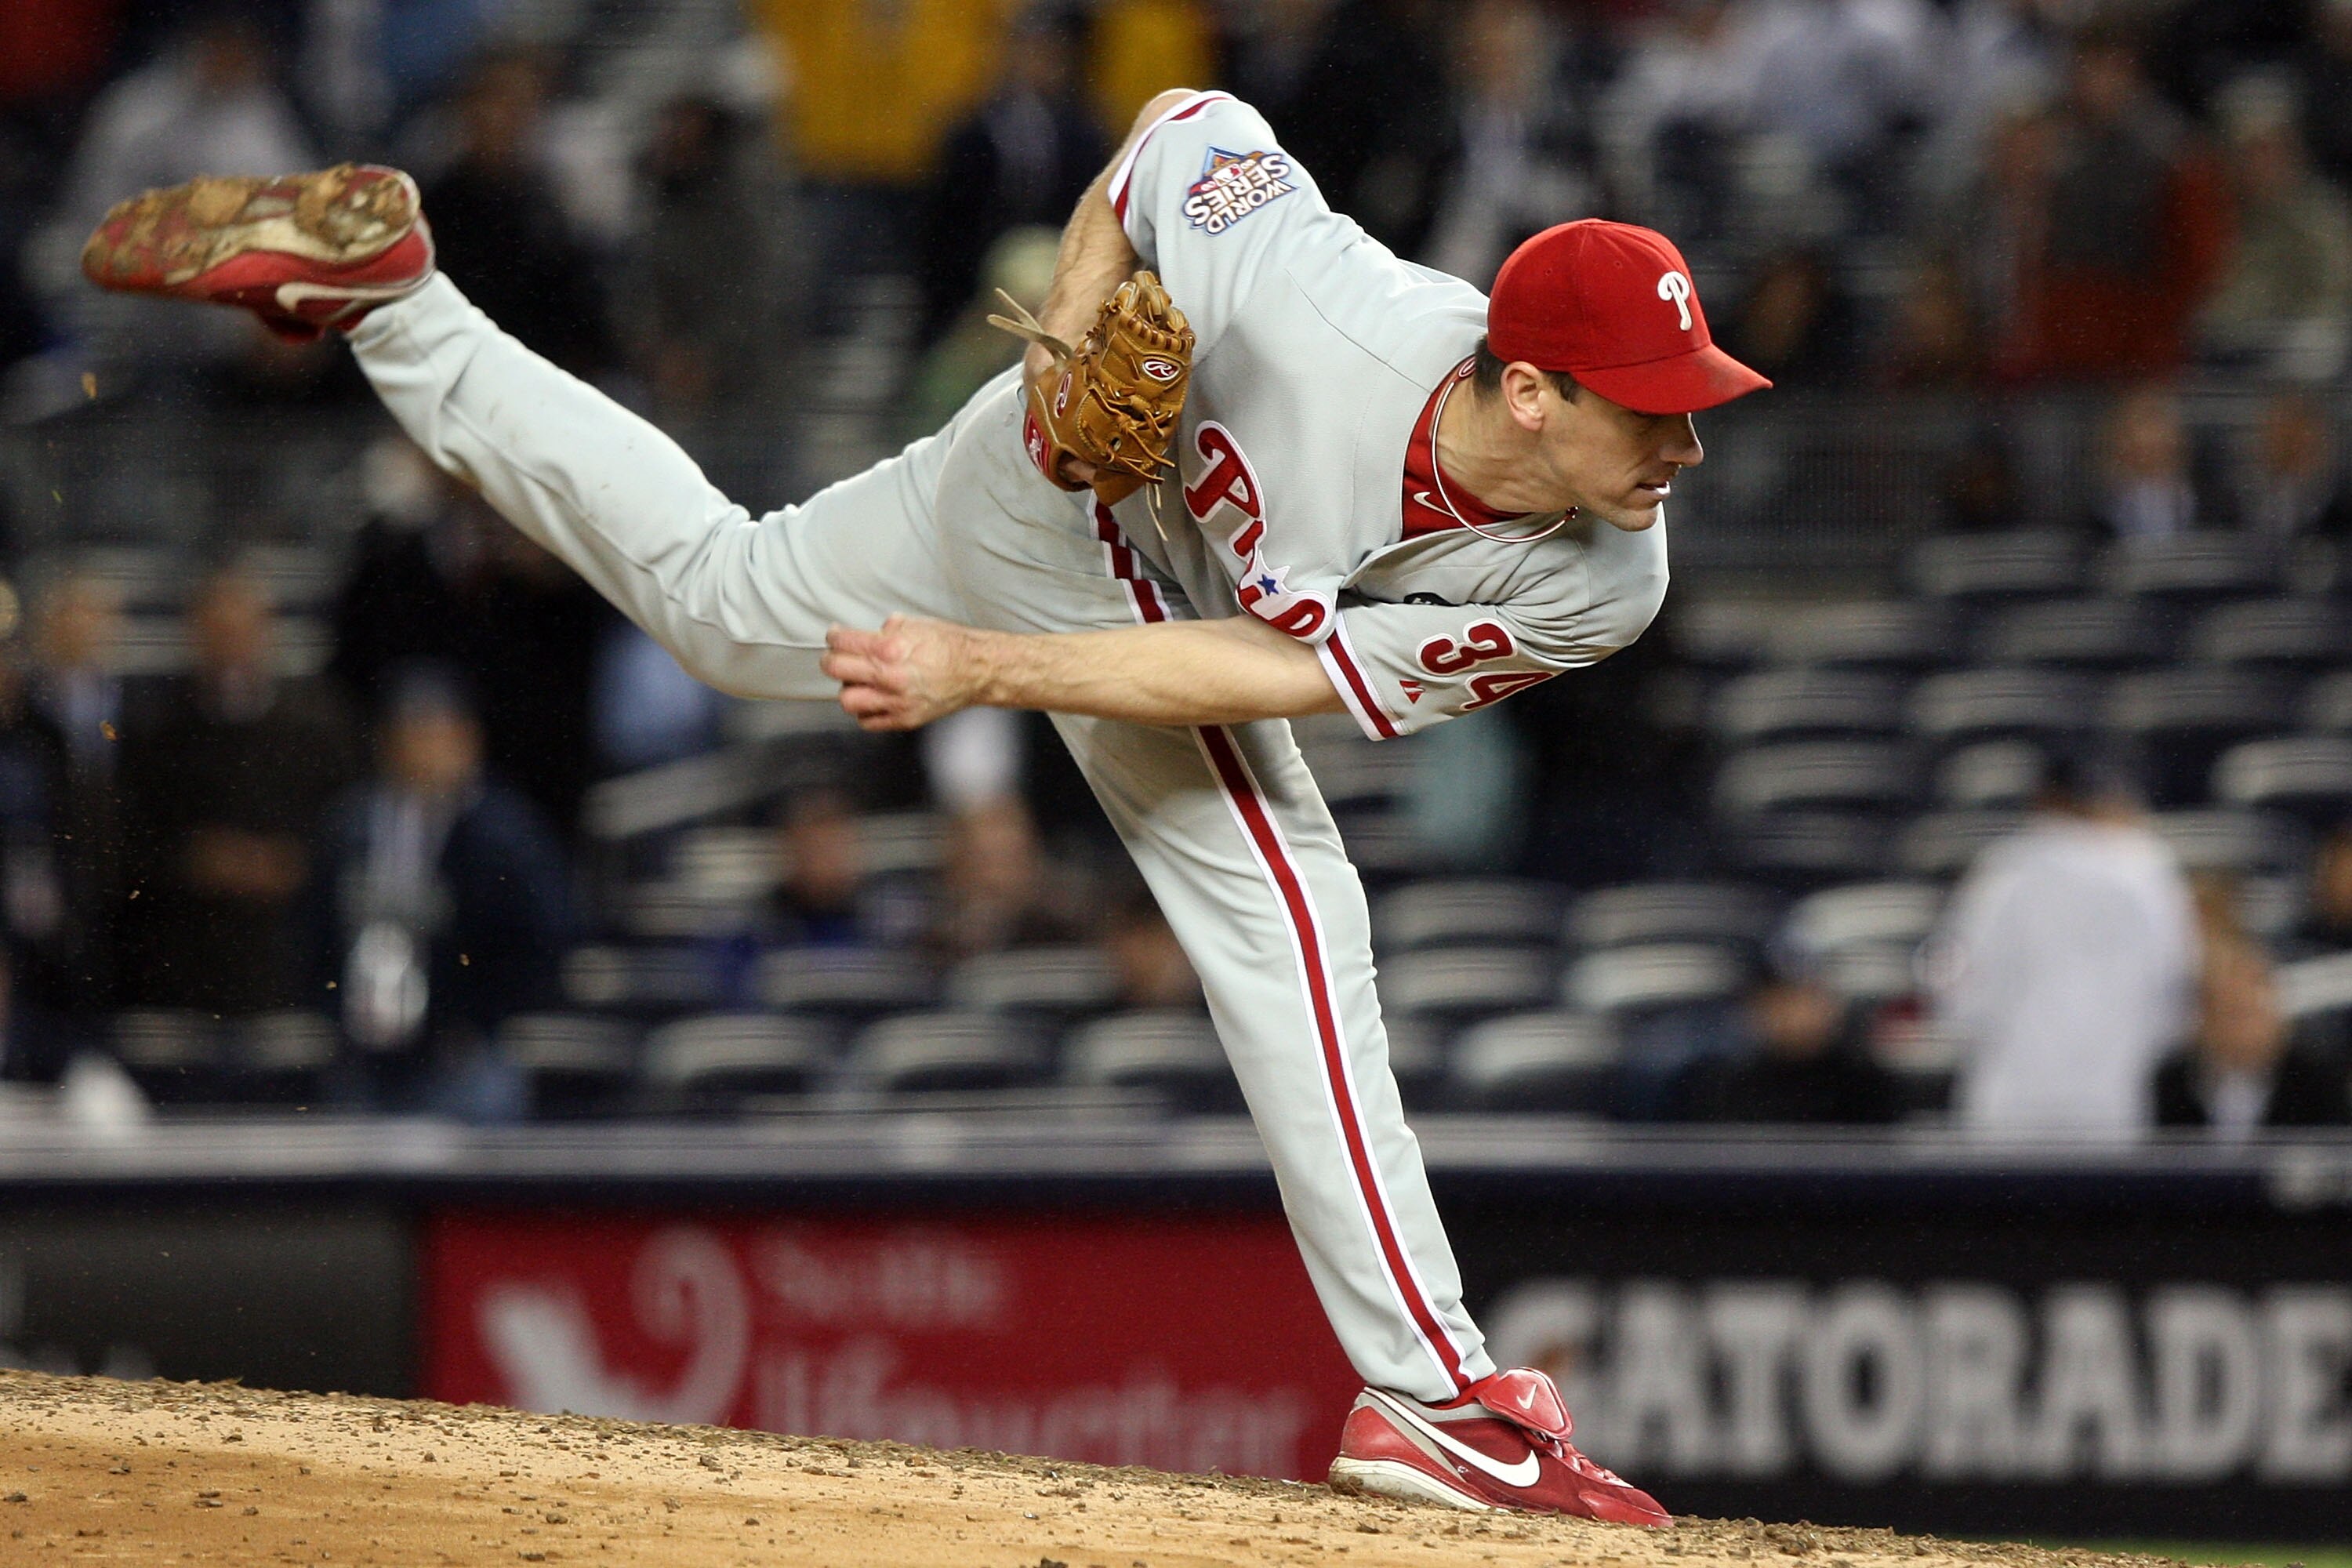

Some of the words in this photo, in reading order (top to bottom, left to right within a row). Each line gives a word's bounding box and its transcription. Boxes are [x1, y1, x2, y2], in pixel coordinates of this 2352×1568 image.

[1183, 154, 1290, 226] SERIES
[1207, 180, 1291, 234] WORLD
[1657, 270, 1693, 331] P
[1416, 617, 1557, 711] 34
[1492, 1281, 2352, 1482] GATORADE
